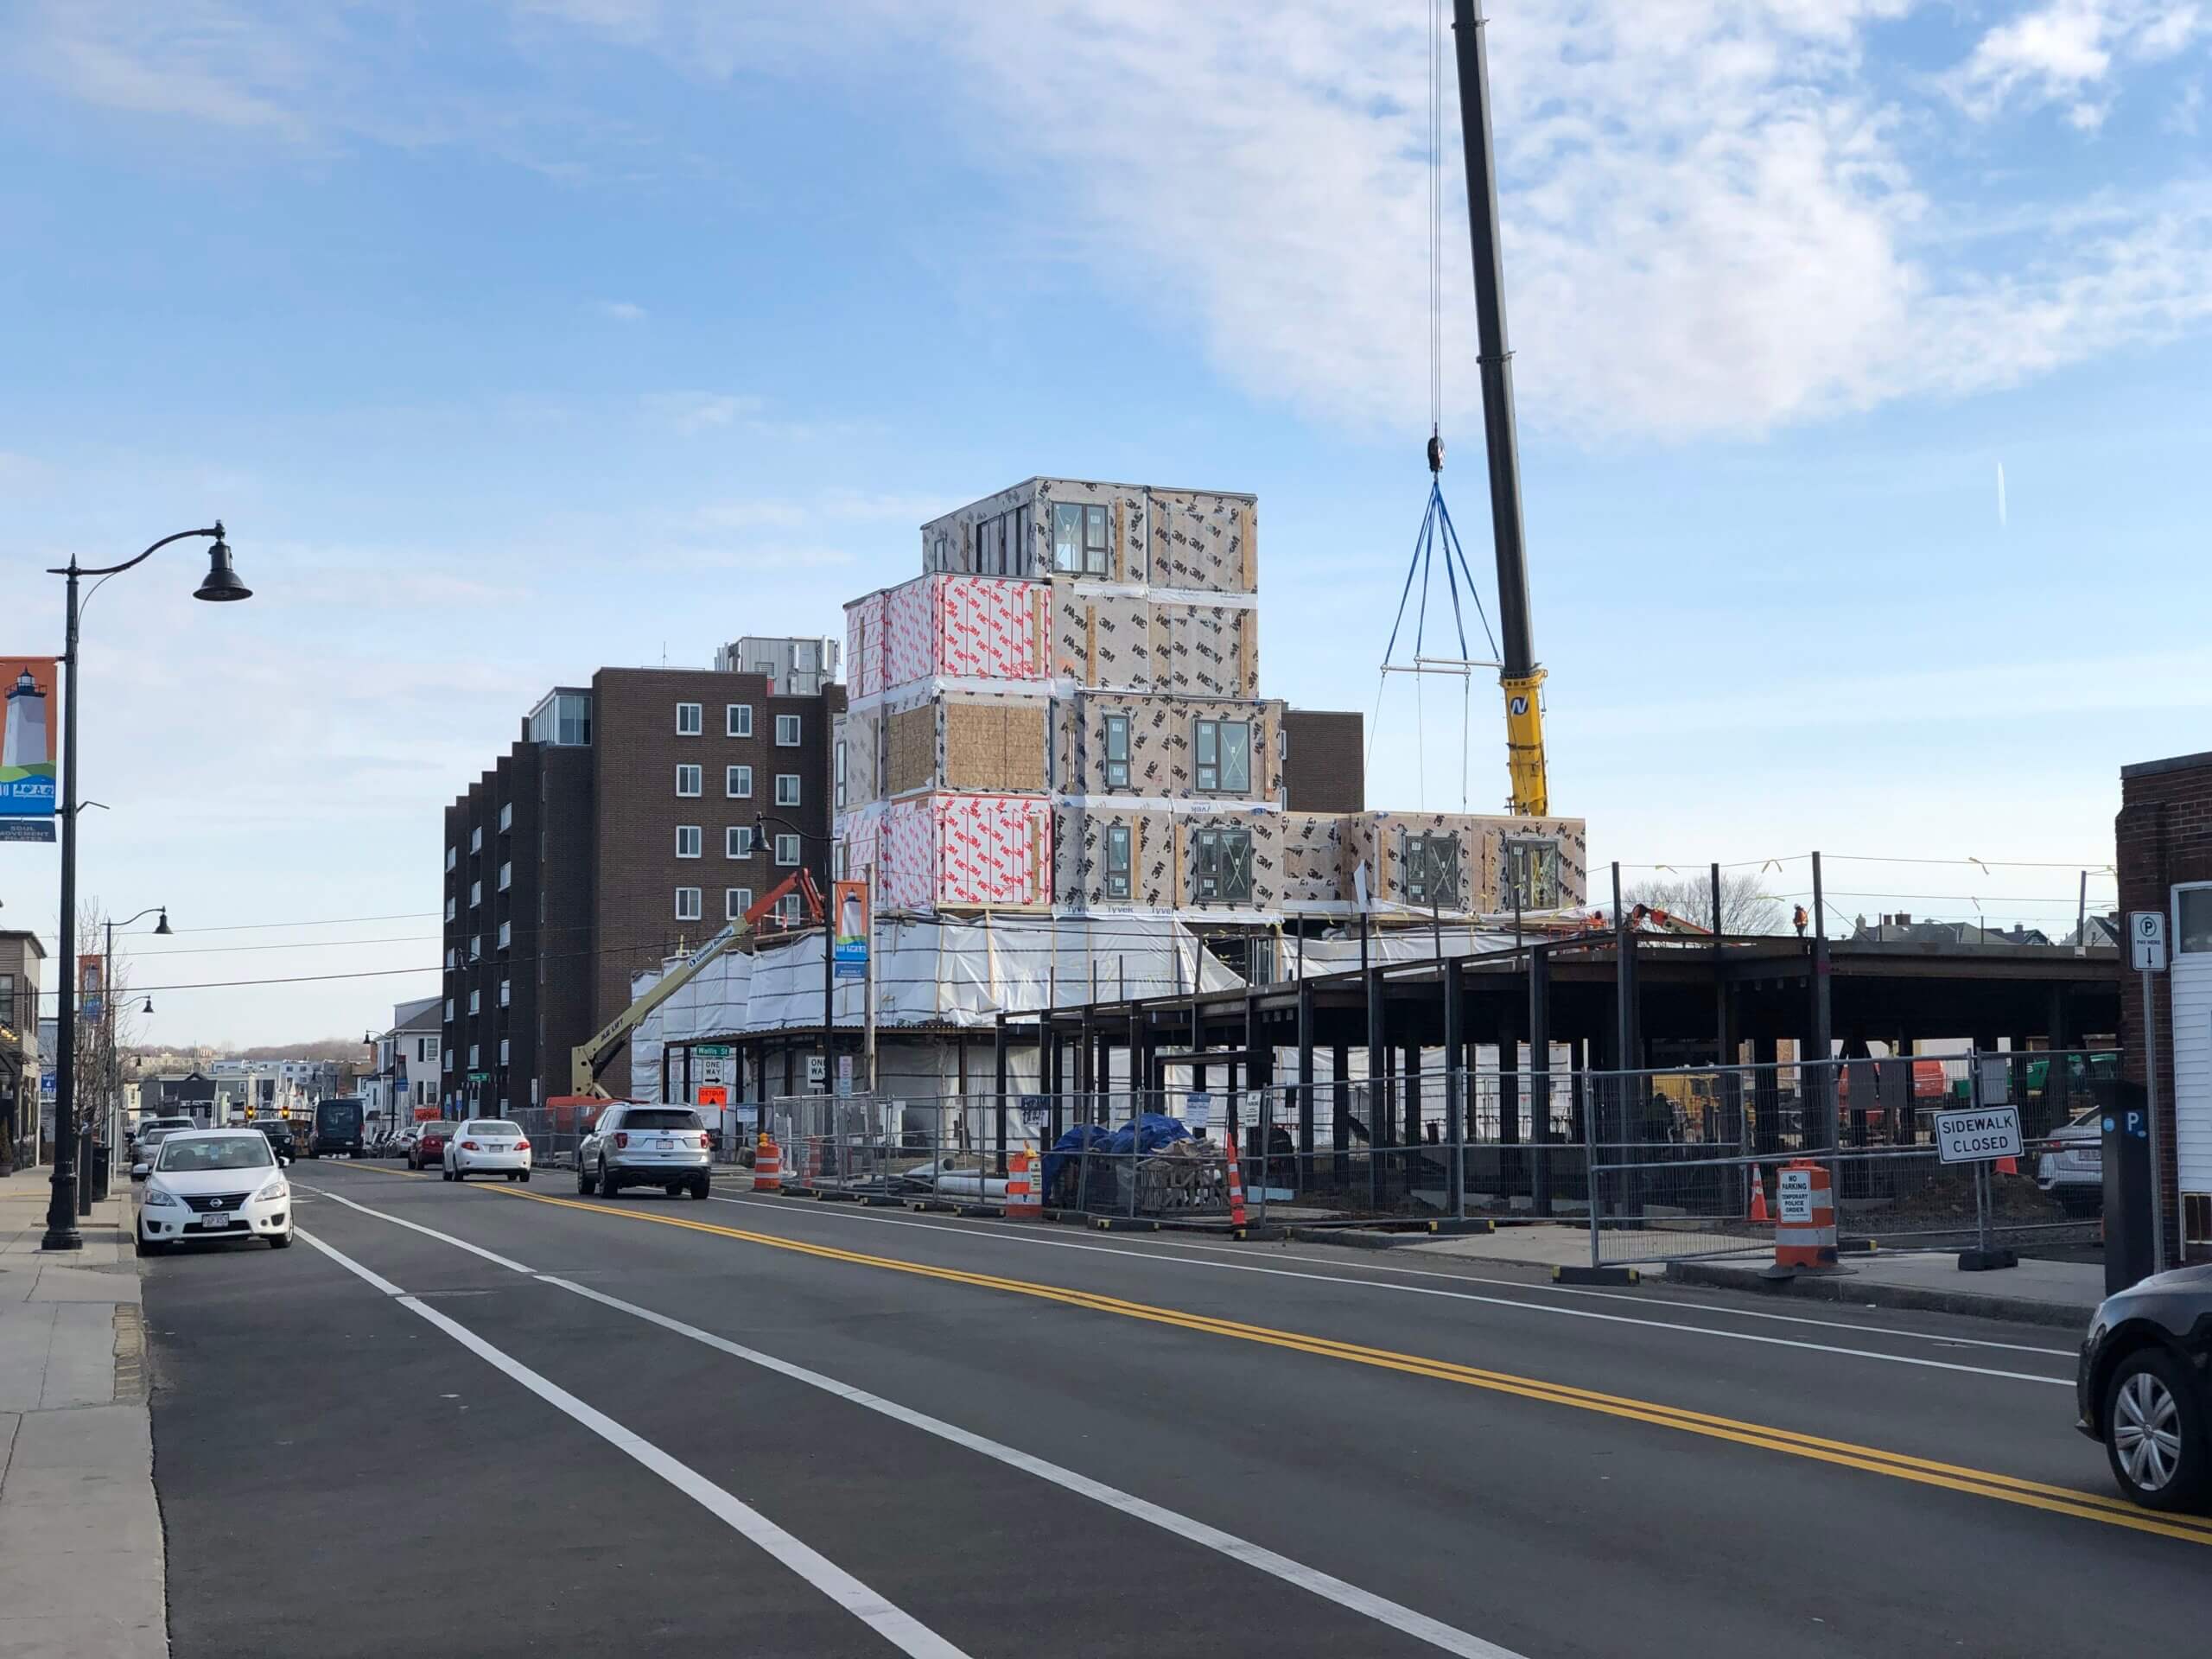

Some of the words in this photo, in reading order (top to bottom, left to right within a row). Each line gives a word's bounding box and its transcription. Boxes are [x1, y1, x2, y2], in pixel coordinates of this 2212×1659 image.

[1129, 536, 1144, 552] 3M
[1172, 530, 1187, 546] 3M
[1189, 537, 1205, 553] 3M
[1129, 565, 1144, 582] 3M
[1172, 559, 1187, 575] 3M
[1189, 567, 1205, 582] 3M
[1074, 615, 1087, 631] 3M
[1099, 617, 1116, 632] 3M
[1074, 645, 1087, 660] 3M
[1099, 647, 1116, 663] 3M
[1173, 642, 1188, 657] 3M
[1173, 671, 1188, 687] 3M
[1172, 734, 1188, 750] 3M
[1172, 766, 1188, 781] 3M
[1257, 825, 1273, 840] 3M
[1152, 861, 1166, 879] 3M
[1257, 855, 1273, 870] 3M
[1147, 888, 1160, 906] 3M
[1257, 886, 1274, 900] 3M
[1108, 905, 1134, 914] Tyvek
[2145, 921, 2152, 933] P
[720, 1046, 729, 1055] St
[1942, 1116, 2013, 1134] SIDEWALK
[2127, 1112, 2139, 1132] P
[1953, 1136, 2008, 1153] CLOSED
